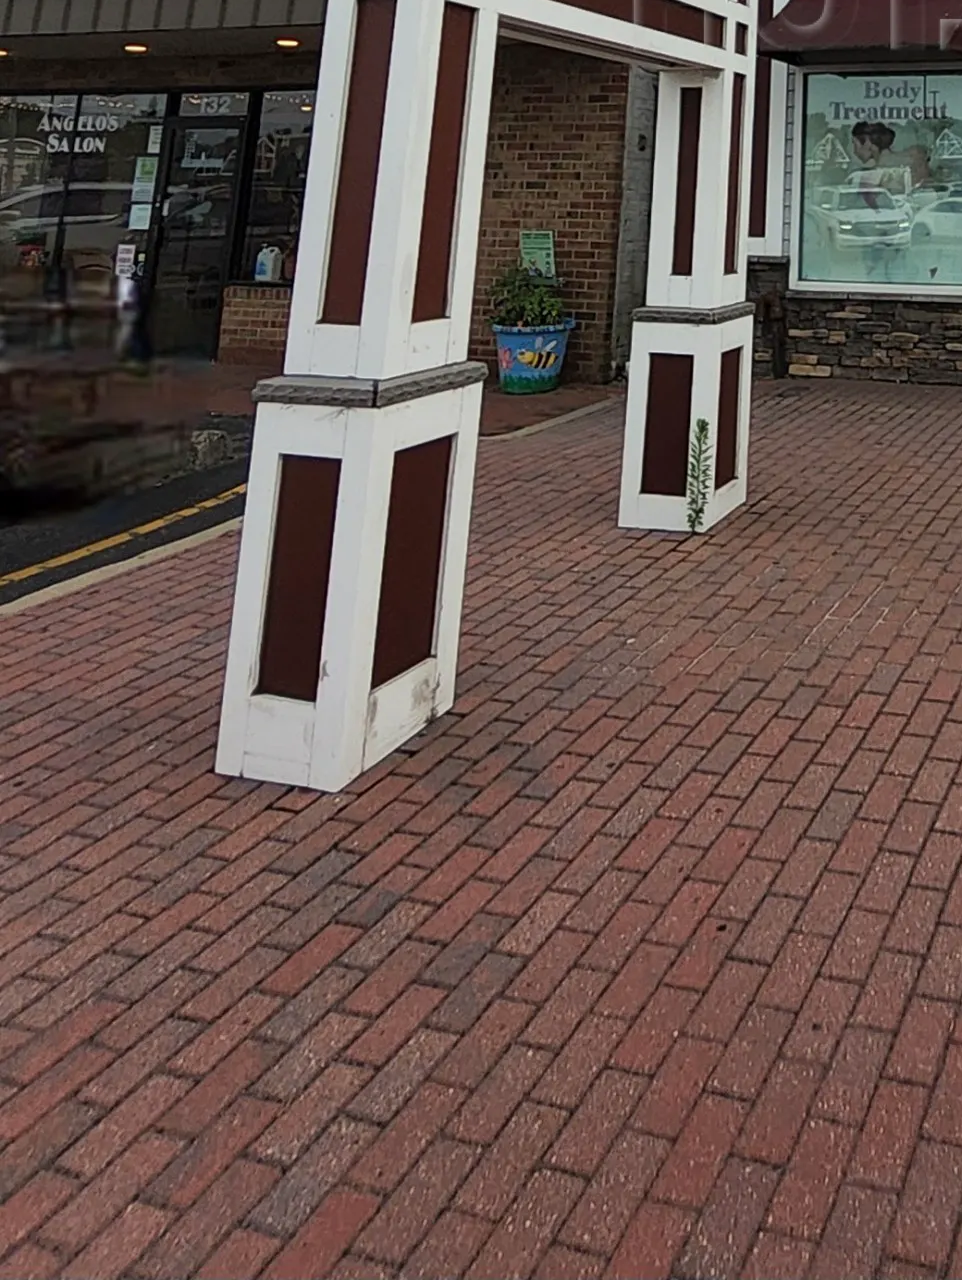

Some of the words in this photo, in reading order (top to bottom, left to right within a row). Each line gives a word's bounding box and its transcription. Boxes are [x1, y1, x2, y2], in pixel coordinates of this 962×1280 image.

[863, 80, 921, 104] Body
[829, 101, 948, 121] Treatment
[36, 112, 120, 132] ANGELO'S
[46, 133, 106, 153] SALON
